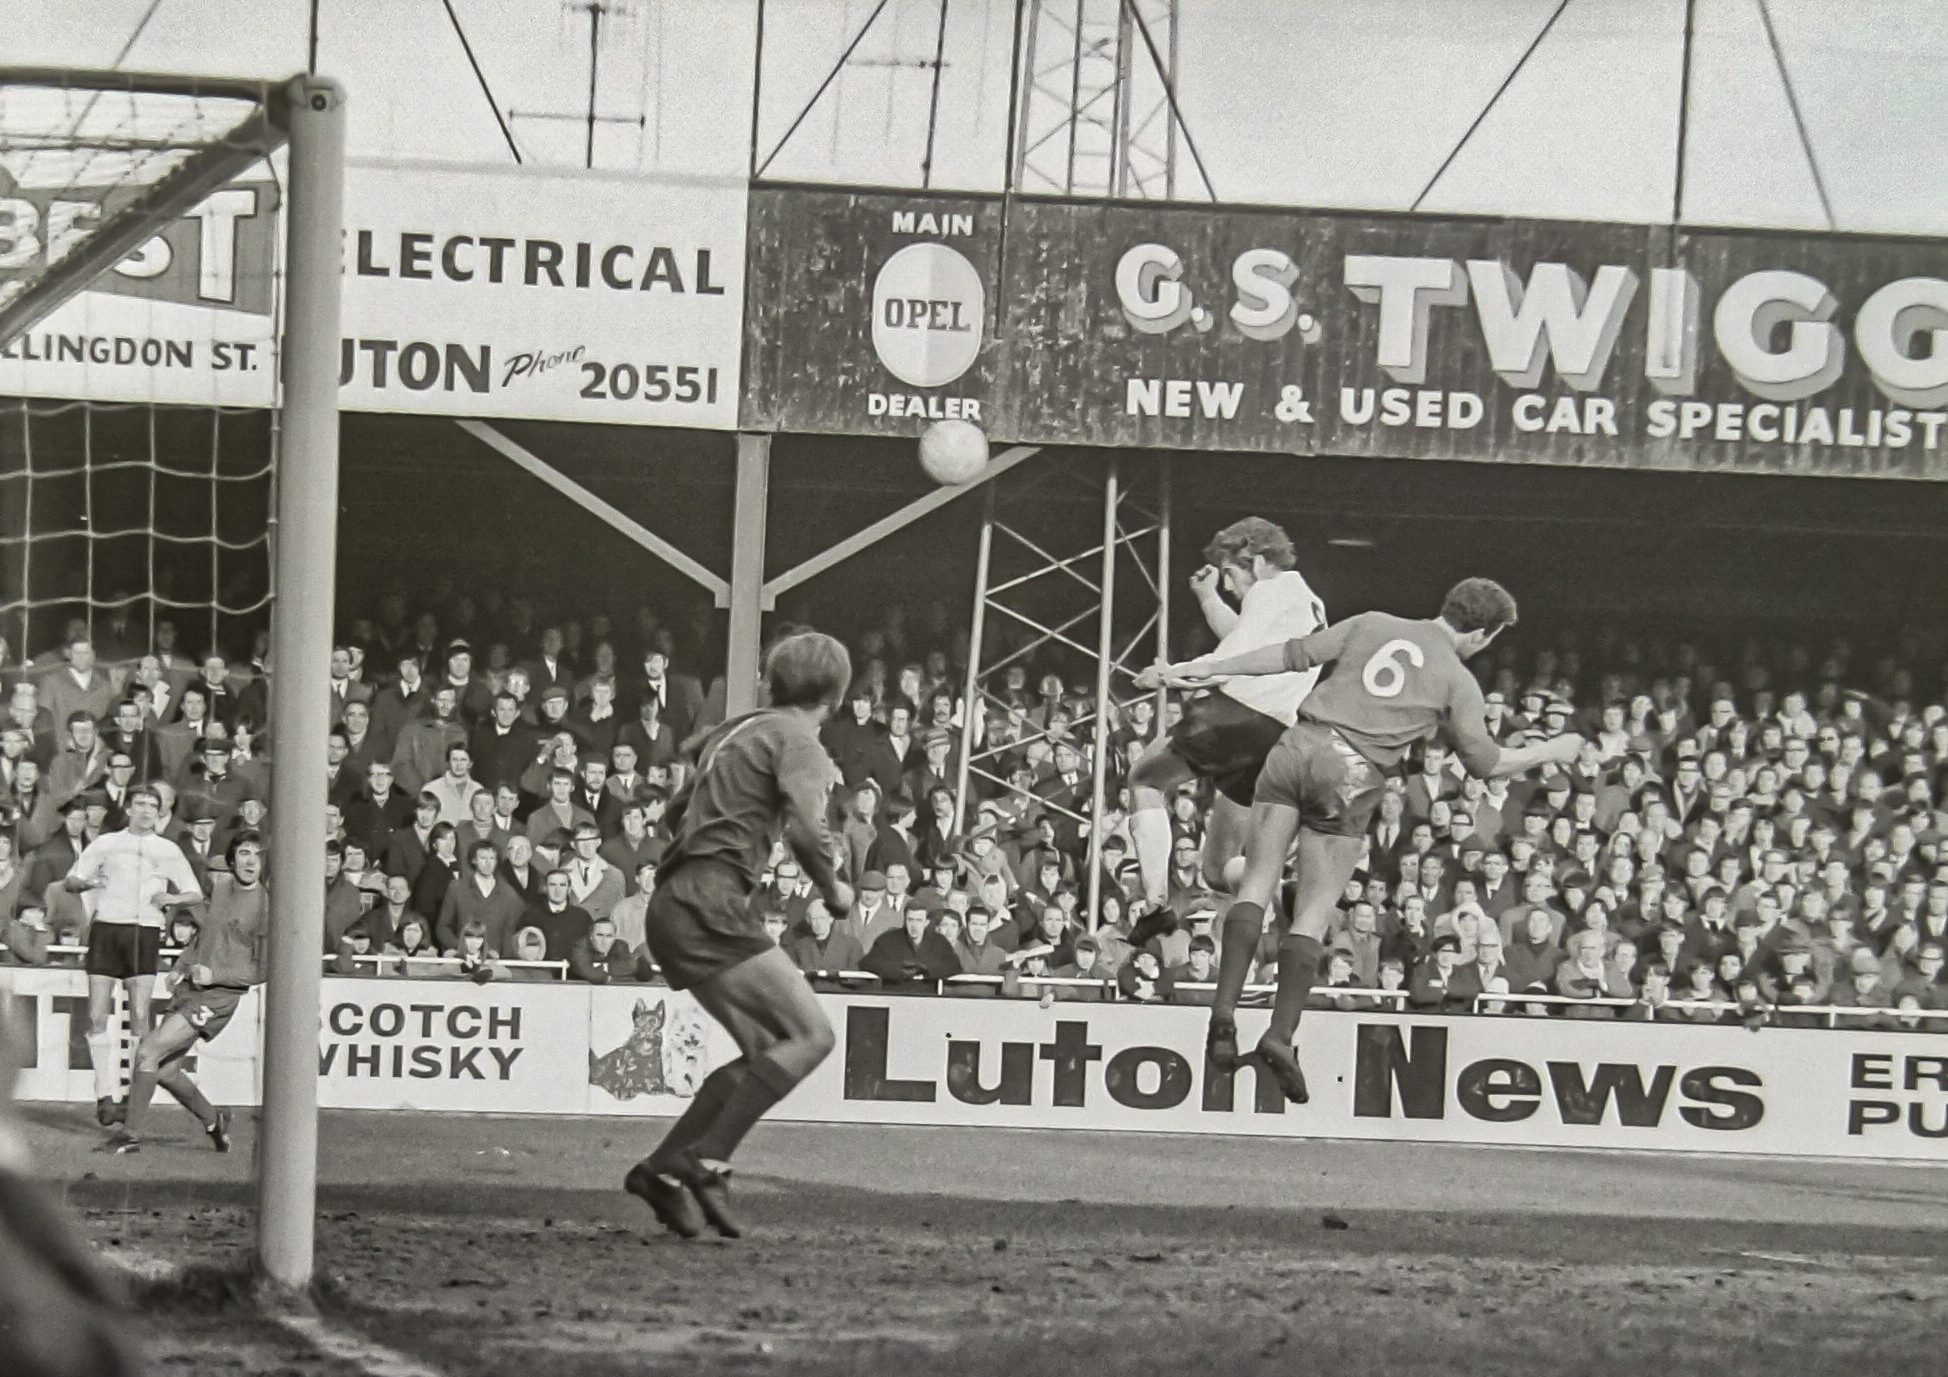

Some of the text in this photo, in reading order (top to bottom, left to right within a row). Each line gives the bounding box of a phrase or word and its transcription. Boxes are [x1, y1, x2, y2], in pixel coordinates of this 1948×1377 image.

[892, 211, 973, 236] MAIN
[341, 229, 725, 295] LECTRICAL
[884, 298, 971, 332] OPEL
[1344, 255, 1948, 410] TWIGG
[211, 343, 257, 371] ST.
[868, 394, 980, 420] DEALER
[1126, 379, 1948, 450] NEW & USED CAR SPECIALIST
[1363, 640, 1424, 697] 6
[319, 1002, 522, 1040] COTCH
[1353, 1023, 1764, 1130] News
[1851, 1053, 1948, 1092] ER
